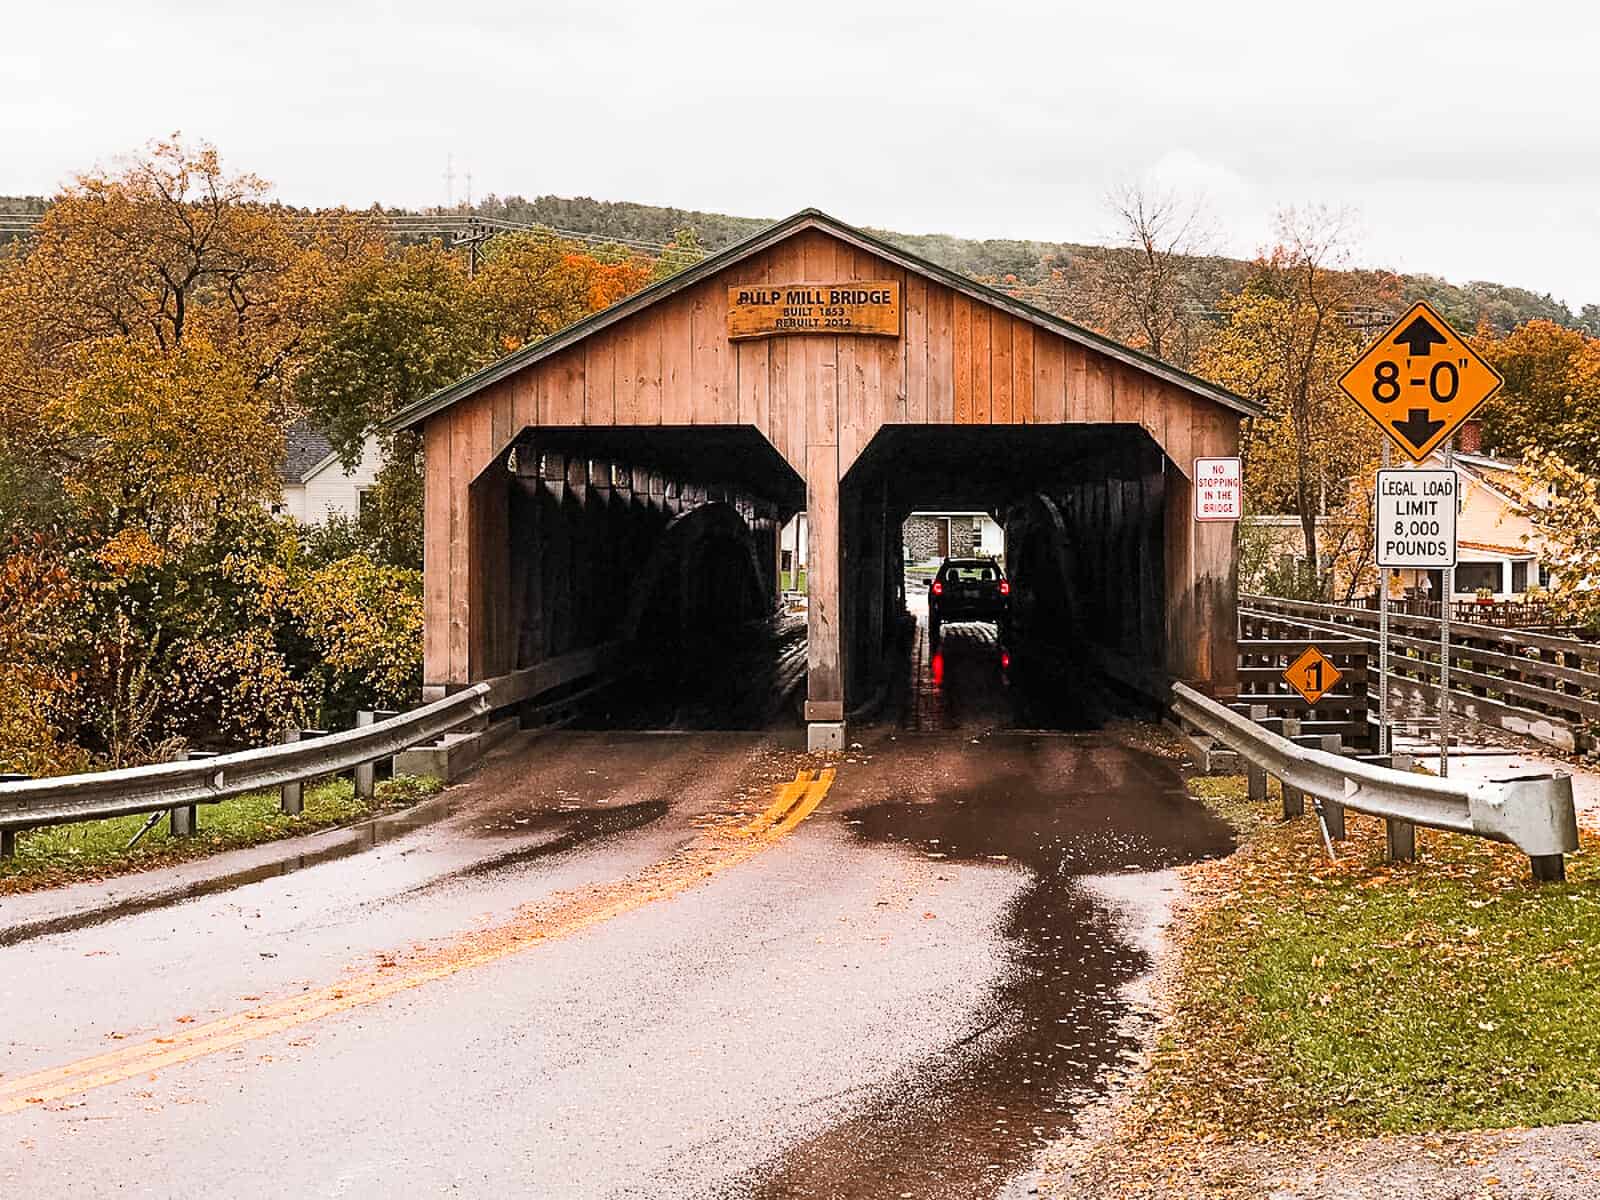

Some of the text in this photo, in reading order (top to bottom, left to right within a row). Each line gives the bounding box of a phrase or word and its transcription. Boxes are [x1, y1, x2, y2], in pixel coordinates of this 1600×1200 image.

[787, 291, 825, 305] MILL
[829, 290, 891, 305] BRIDGE
[783, 307, 813, 316] BUILT
[775, 318, 850, 328] REBUILT 2012
[1371, 358, 1468, 404] 8'-0"
[1212, 465, 1224, 474] NO
[1199, 478, 1238, 487] STOPPING
[1382, 481, 1453, 497] LEGAL LOAD
[1204, 491, 1232, 500] IN THE
[1204, 504, 1233, 512] BRIDGE
[1395, 501, 1438, 516] LIMIT
[1394, 521, 1440, 538] 8,000
[1385, 541, 1447, 556] POUNDS
